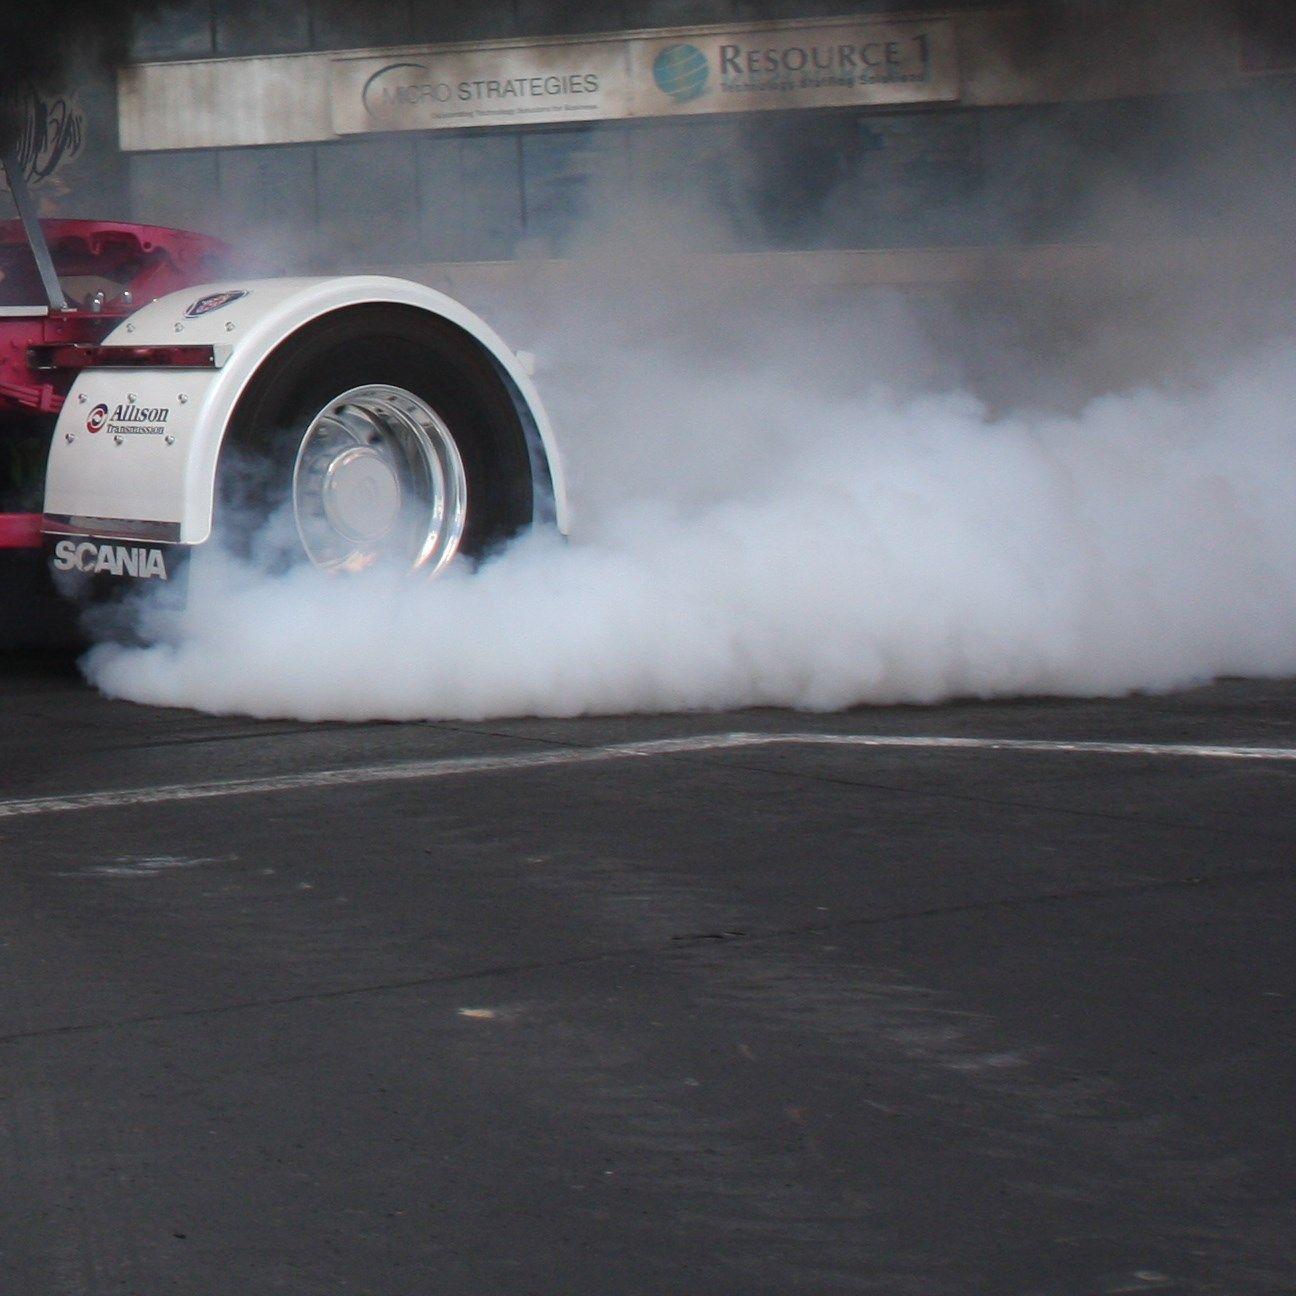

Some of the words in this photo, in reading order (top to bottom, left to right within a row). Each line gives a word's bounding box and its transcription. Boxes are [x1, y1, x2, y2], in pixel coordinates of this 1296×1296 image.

[382, 83, 452, 106] MICRO
[457, 74, 600, 102] STRATEGIES
[109, 404, 170, 423] Allison
[106, 423, 165, 435] Transmission
[54, 539, 168, 581] SCANIA
